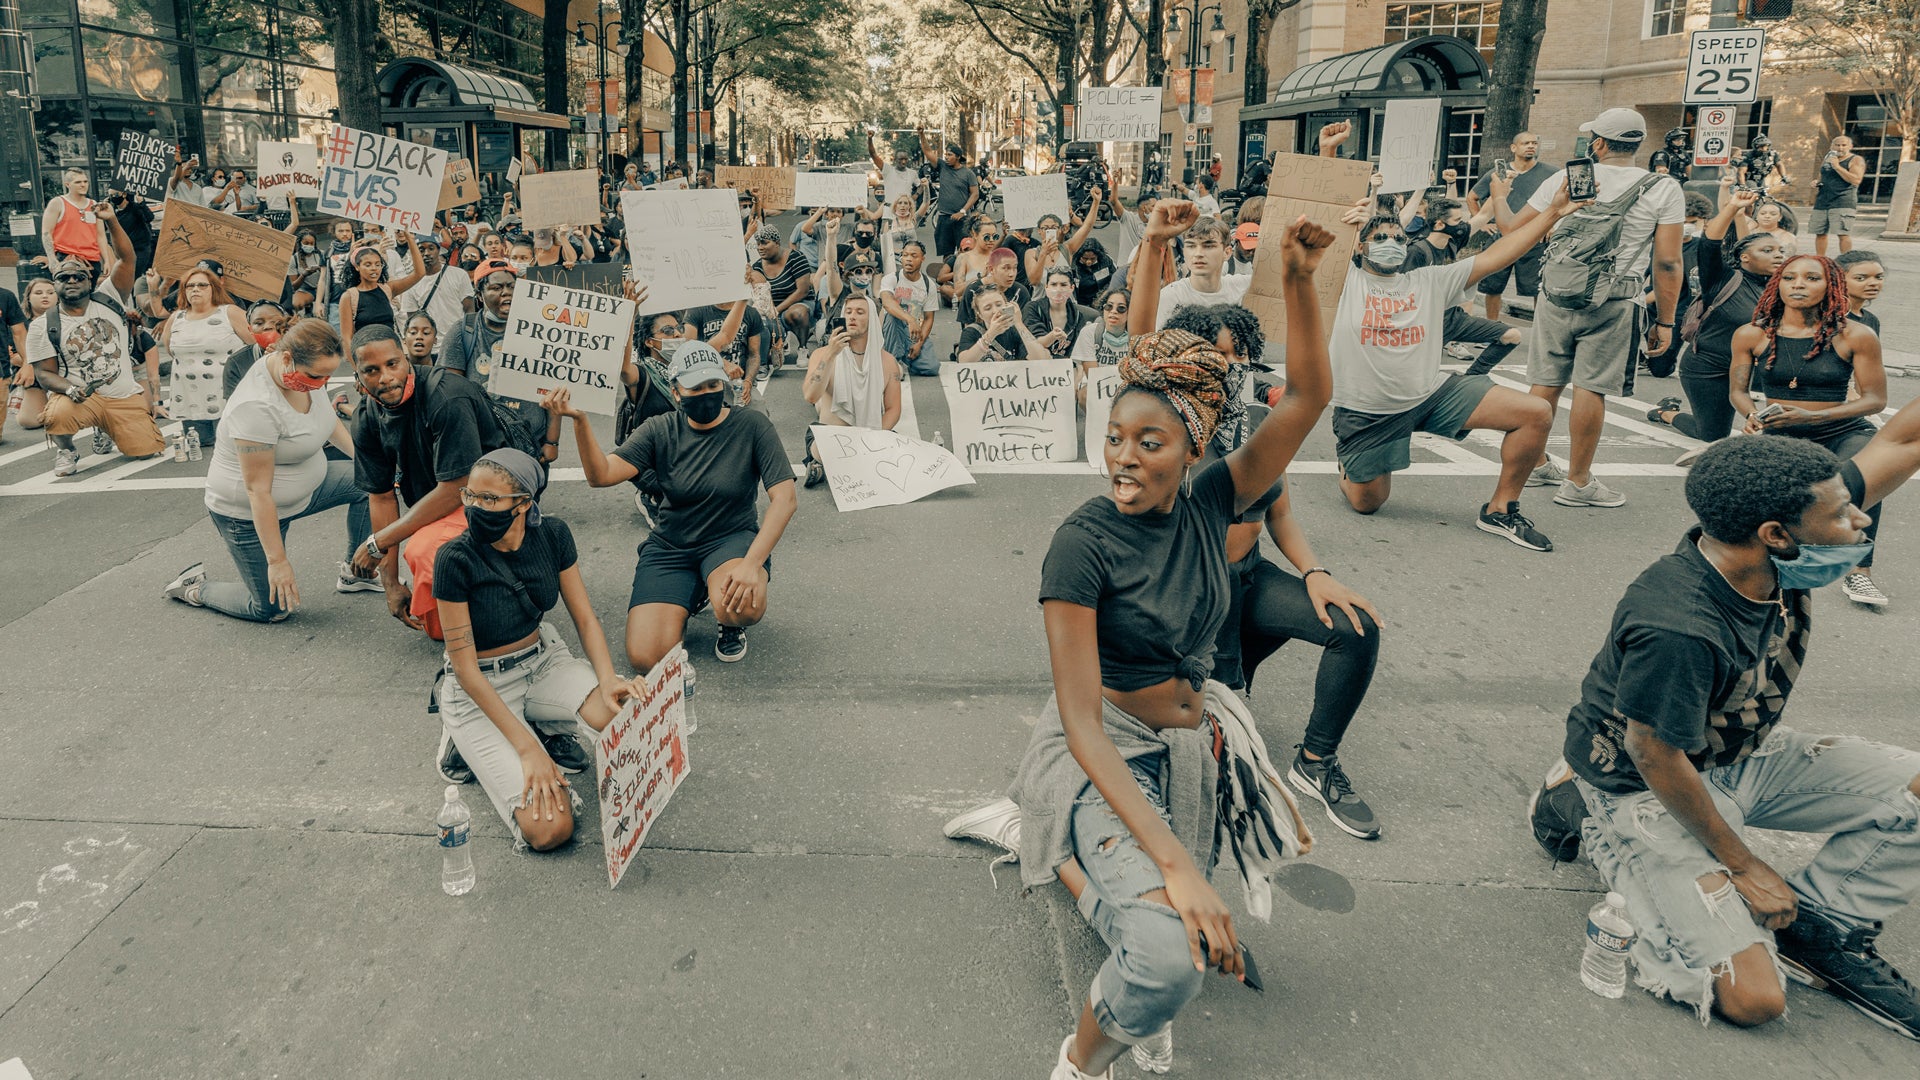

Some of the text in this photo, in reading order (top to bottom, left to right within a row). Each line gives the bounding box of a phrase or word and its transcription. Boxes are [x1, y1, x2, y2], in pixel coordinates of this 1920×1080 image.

[1697, 37, 1758, 50] SPEED
[1701, 52, 1750, 65] LIMIT
[1693, 67, 1753, 95] 25
[1088, 90, 1137, 105] POLICE
[1085, 123, 1158, 139] EXECUTIONER
[128, 131, 168, 157] BLACK
[329, 127, 436, 177] #BLACK
[119, 148, 166, 173] FUTURES
[1277, 158, 1334, 177] STOP
[259, 173, 291, 190] AGAINST
[718, 167, 786, 180] ONLY YOU CAN
[124, 182, 148, 195] ACAB
[322, 166, 400, 208] LIVES
[1300, 176, 1336, 195] THE
[762, 194, 791, 205] PEACE
[345, 198, 421, 230] MATTER
[218, 256, 252, 273] STANDS
[1255, 247, 1347, 279] POCE
[527, 282, 623, 315] IF THEY
[1365, 293, 1418, 314] PEOPLE
[542, 303, 590, 329] CAN
[703, 319, 748, 334] JOHY
[1361, 310, 1395, 329] ARE
[515, 319, 615, 351] PROTEST
[1360, 325, 1425, 346] PISSED!
[540, 343, 582, 366] FOR
[683, 349, 719, 370] HEELS
[957, 367, 1072, 393] Black Lives
[1097, 374, 1119, 400] FU
[981, 395, 1058, 424] ALWAYS
[612, 748, 641, 771] VOICE
[613, 752, 651, 816] SILENT
